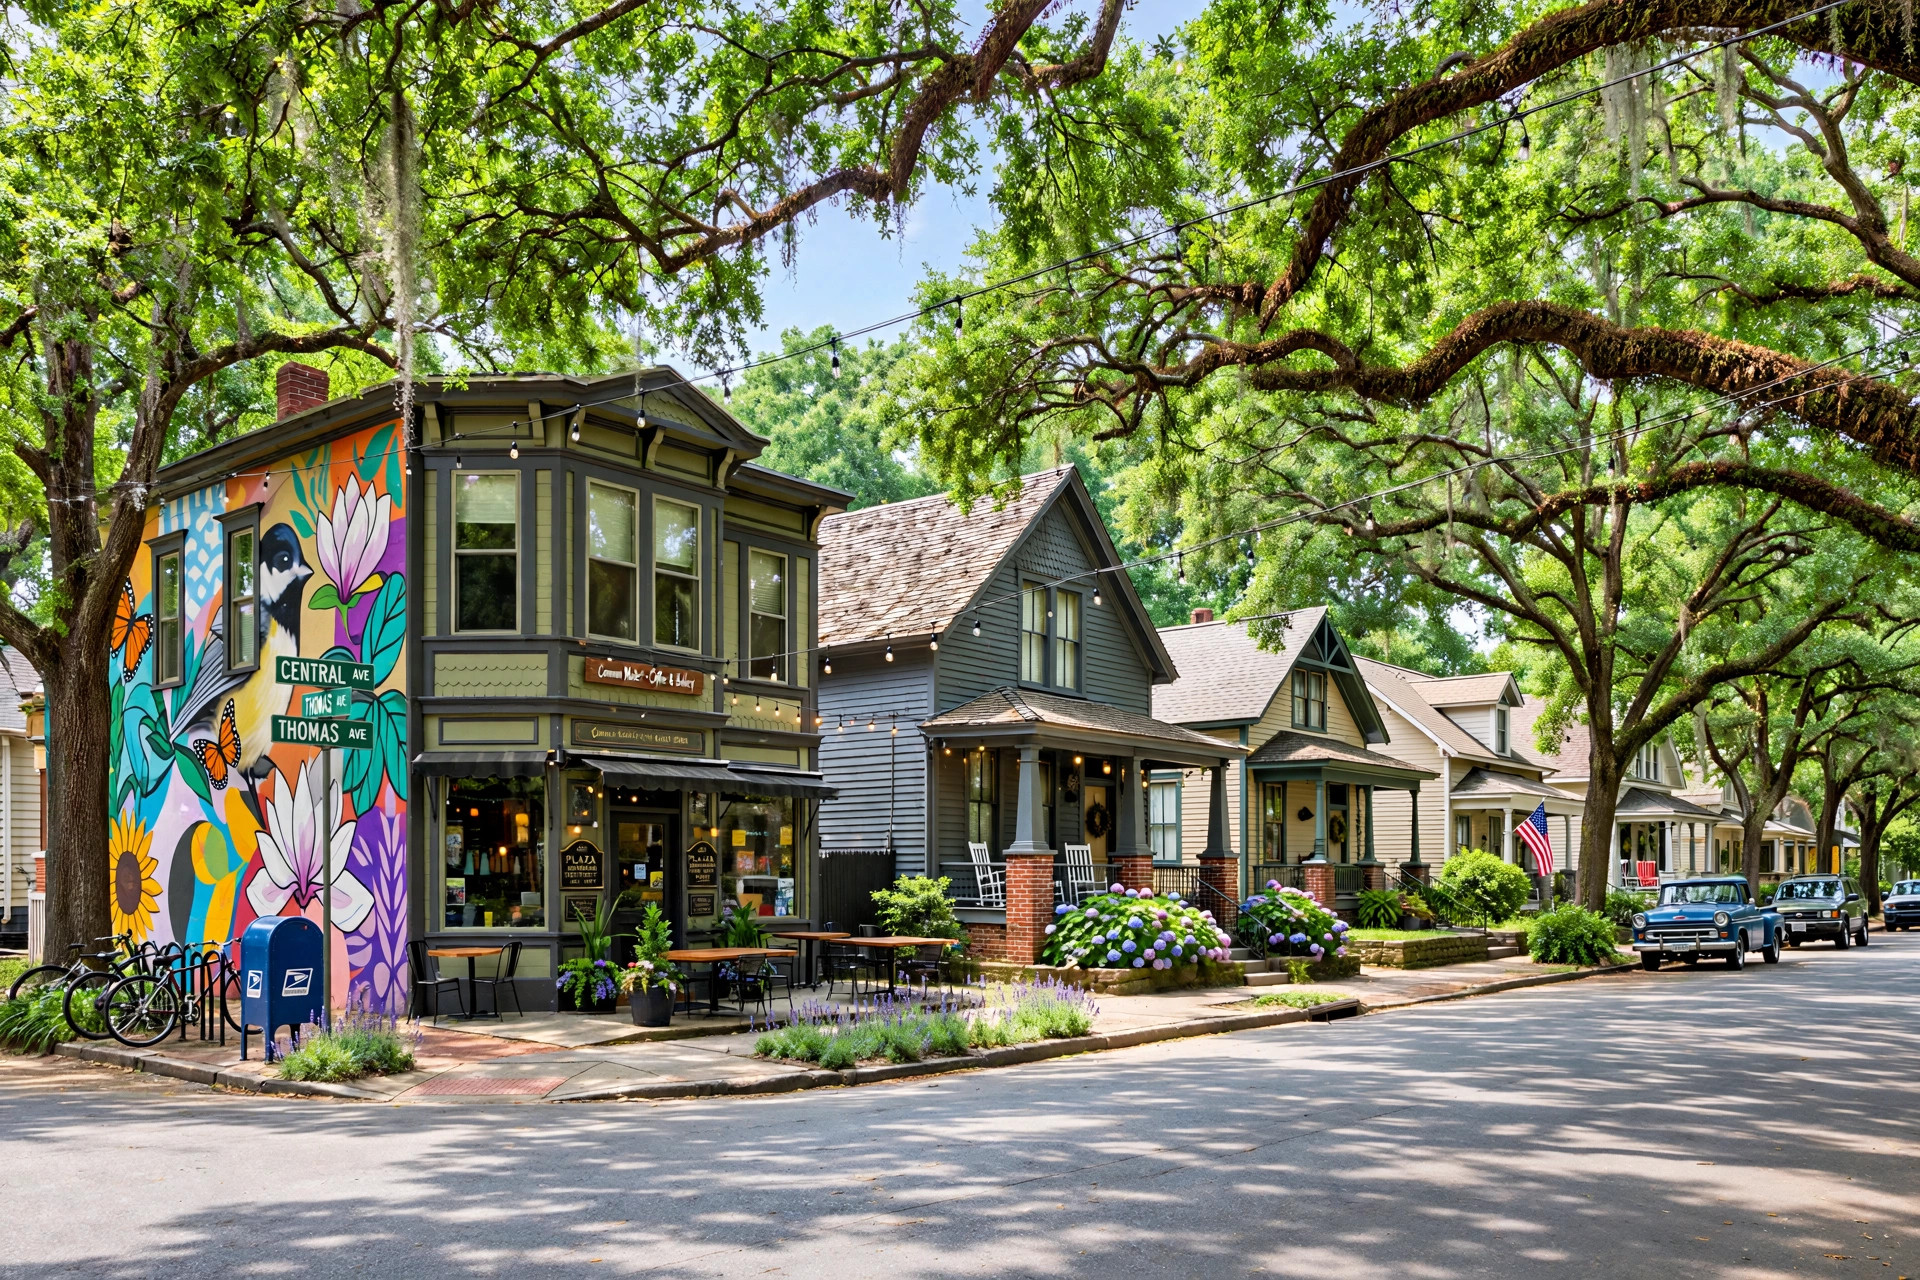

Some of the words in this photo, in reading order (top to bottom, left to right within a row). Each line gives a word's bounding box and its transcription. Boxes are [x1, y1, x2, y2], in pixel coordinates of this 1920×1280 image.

[281, 659, 346, 685] CENTRAL
[352, 668, 370, 681] AVE
[305, 693, 333, 717] THOMAS
[278, 719, 339, 743] THOMAS
[348, 727, 367, 741] AVE
[565, 854, 596, 865] PLAZA
